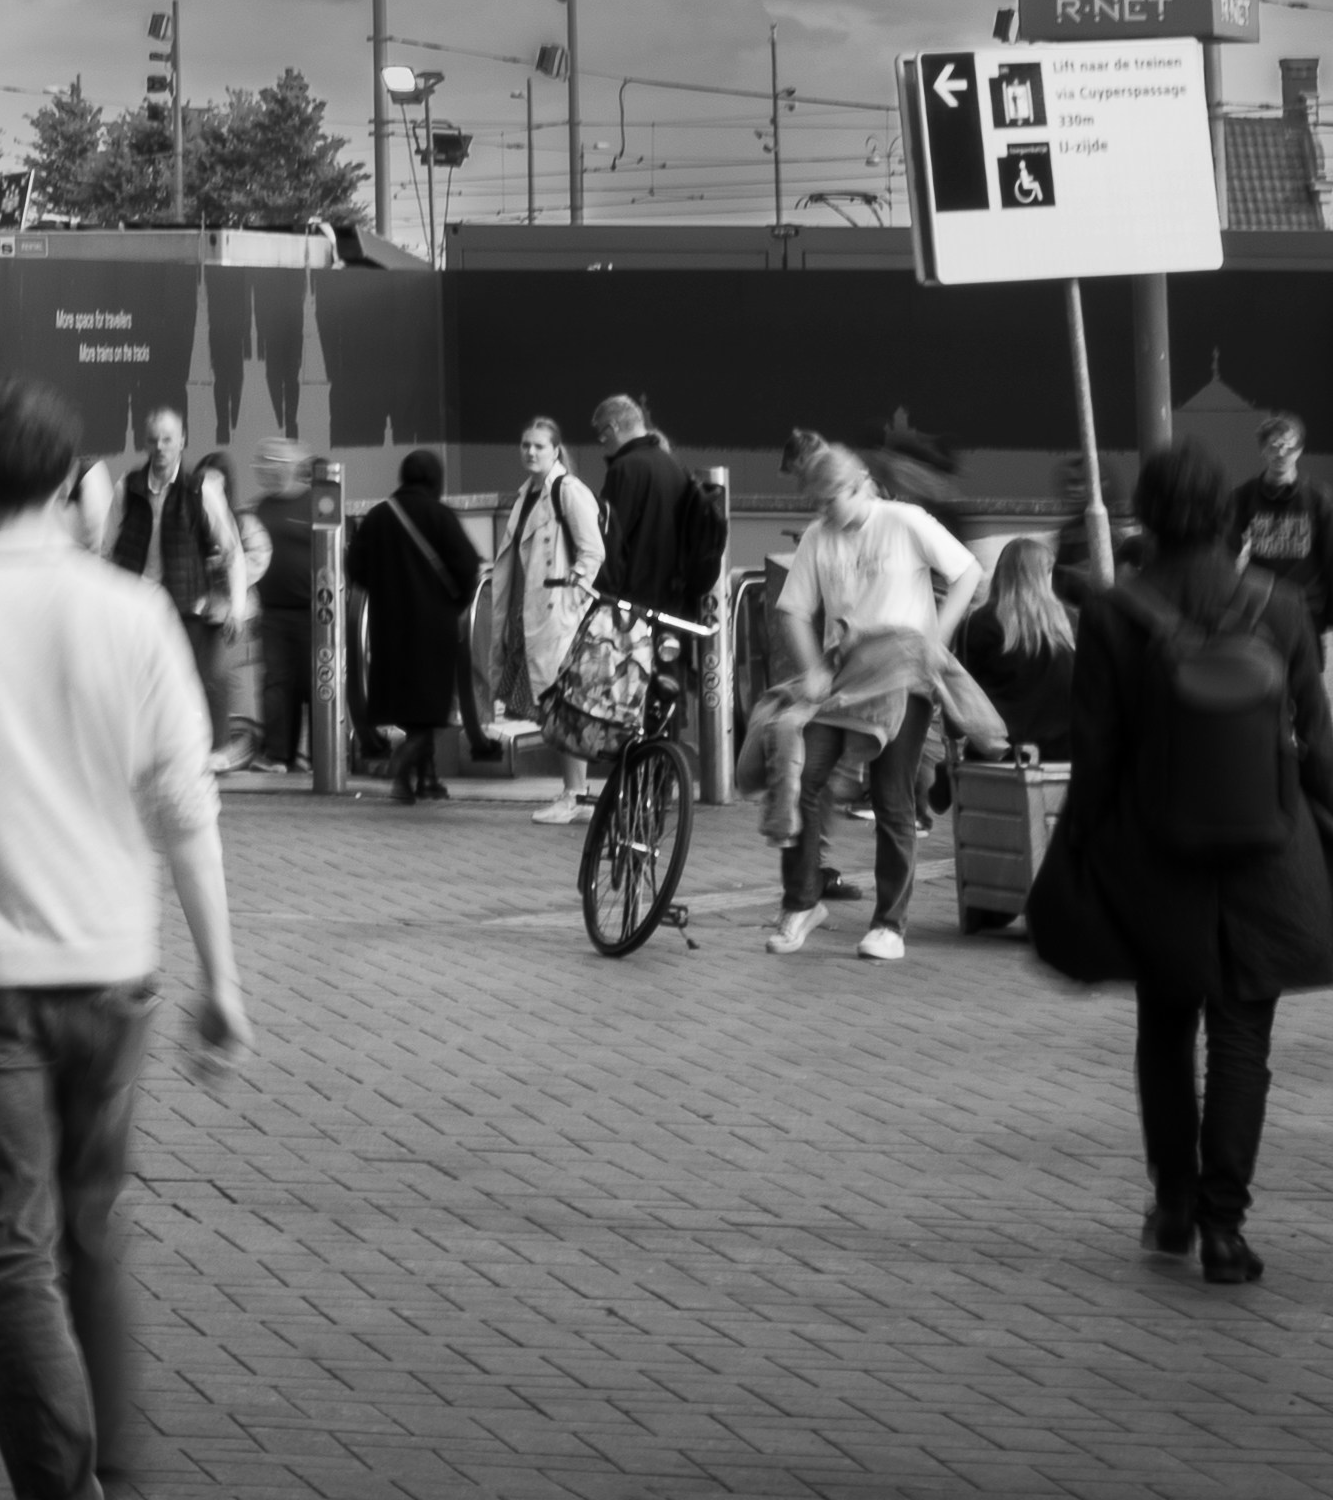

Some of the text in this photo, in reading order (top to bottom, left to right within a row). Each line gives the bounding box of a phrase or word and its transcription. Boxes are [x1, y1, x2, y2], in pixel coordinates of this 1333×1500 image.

[1053, 56, 1182, 74] Lift naar de treinen
[1055, 84, 1187, 102] via Cuyperspassage
[55, 308, 74, 330] More
